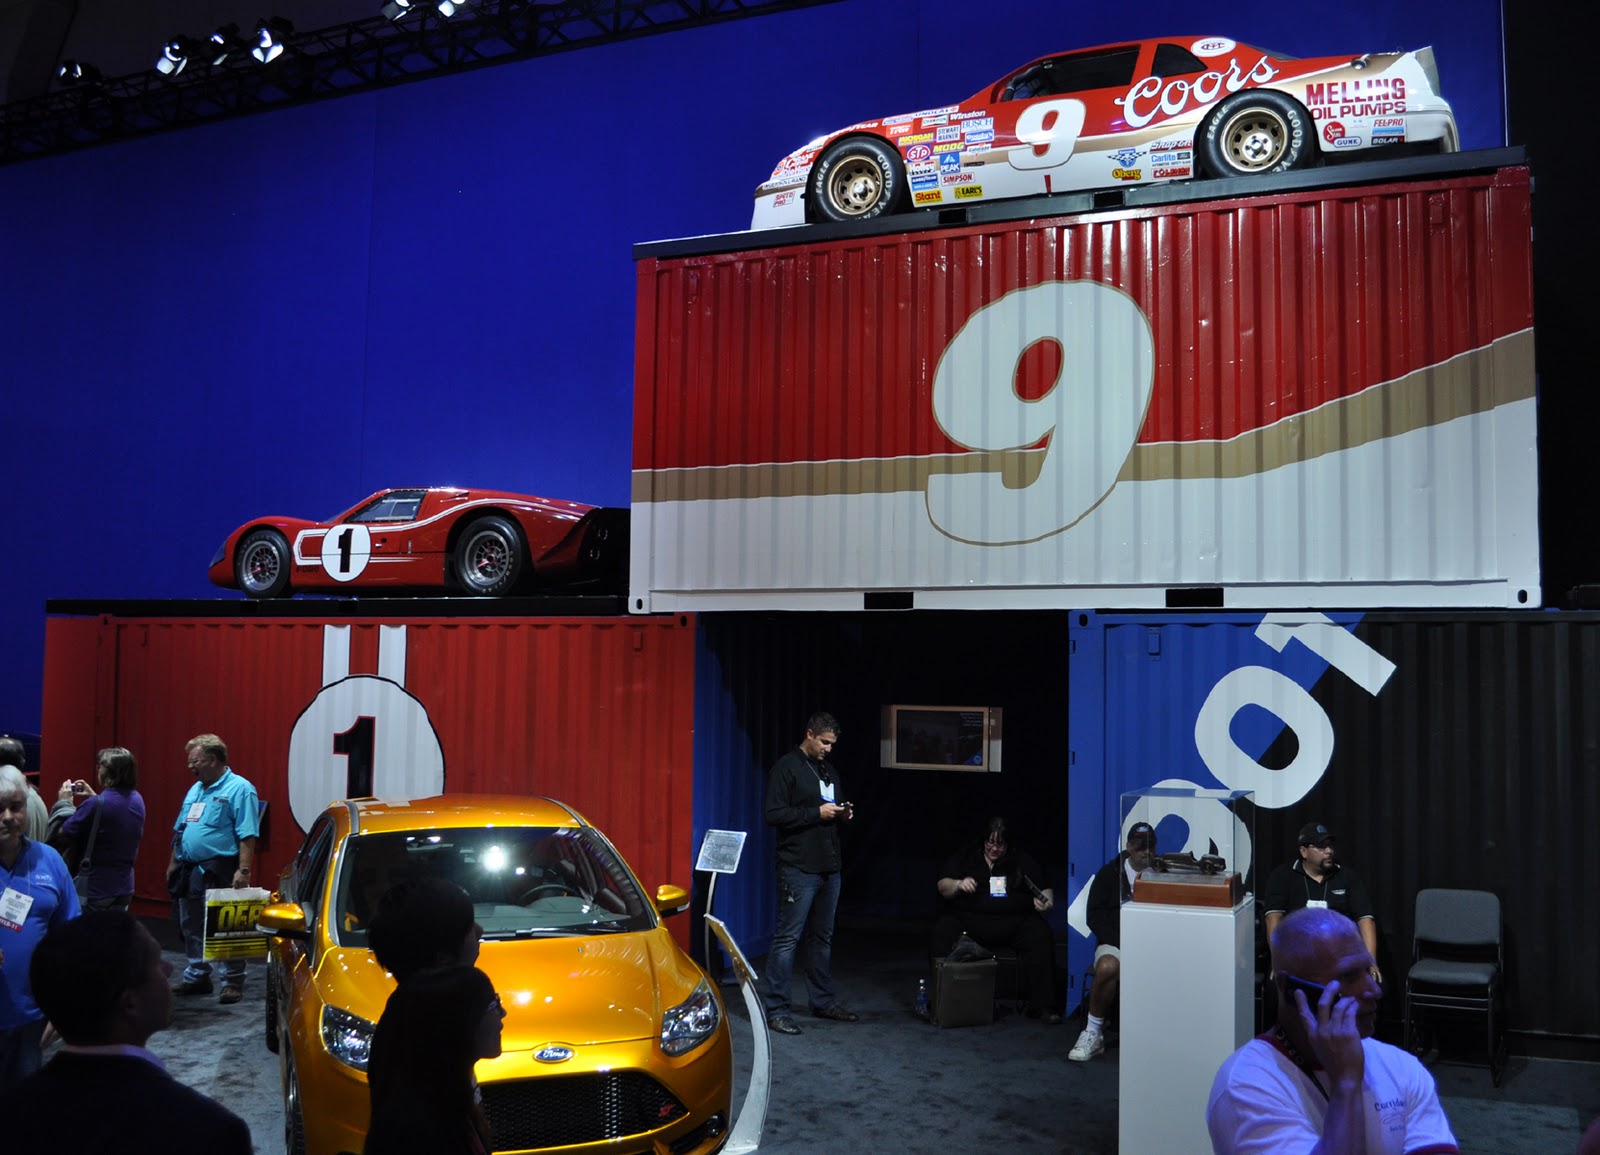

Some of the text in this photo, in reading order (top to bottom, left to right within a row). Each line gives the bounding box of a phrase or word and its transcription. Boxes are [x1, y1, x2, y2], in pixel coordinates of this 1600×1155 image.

[1114, 55, 1280, 128] Coors
[1305, 78, 1406, 106] MELLING
[950, 111, 986, 120] Winston
[1310, 101, 1406, 121] OIL PUMPS
[962, 118, 992, 129] BUSCH
[1206, 105, 1229, 140] EAGLE
[1008, 98, 1086, 171] 9
[933, 142, 964, 153] MOOG
[1337, 138, 1358, 146] GUNK
[910, 146, 928, 159] STP
[1151, 154, 1176, 163] Carlite
[941, 163, 960, 173] PEAK
[1112, 168, 1141, 180] Oberg
[816, 161, 830, 194] EAGLE
[943, 174, 973, 183] SIMPSON
[915, 191, 942, 202] Stant
[924, 280, 1155, 545] 9
[338, 528, 354, 573] 1
[333, 715, 376, 800] 1
